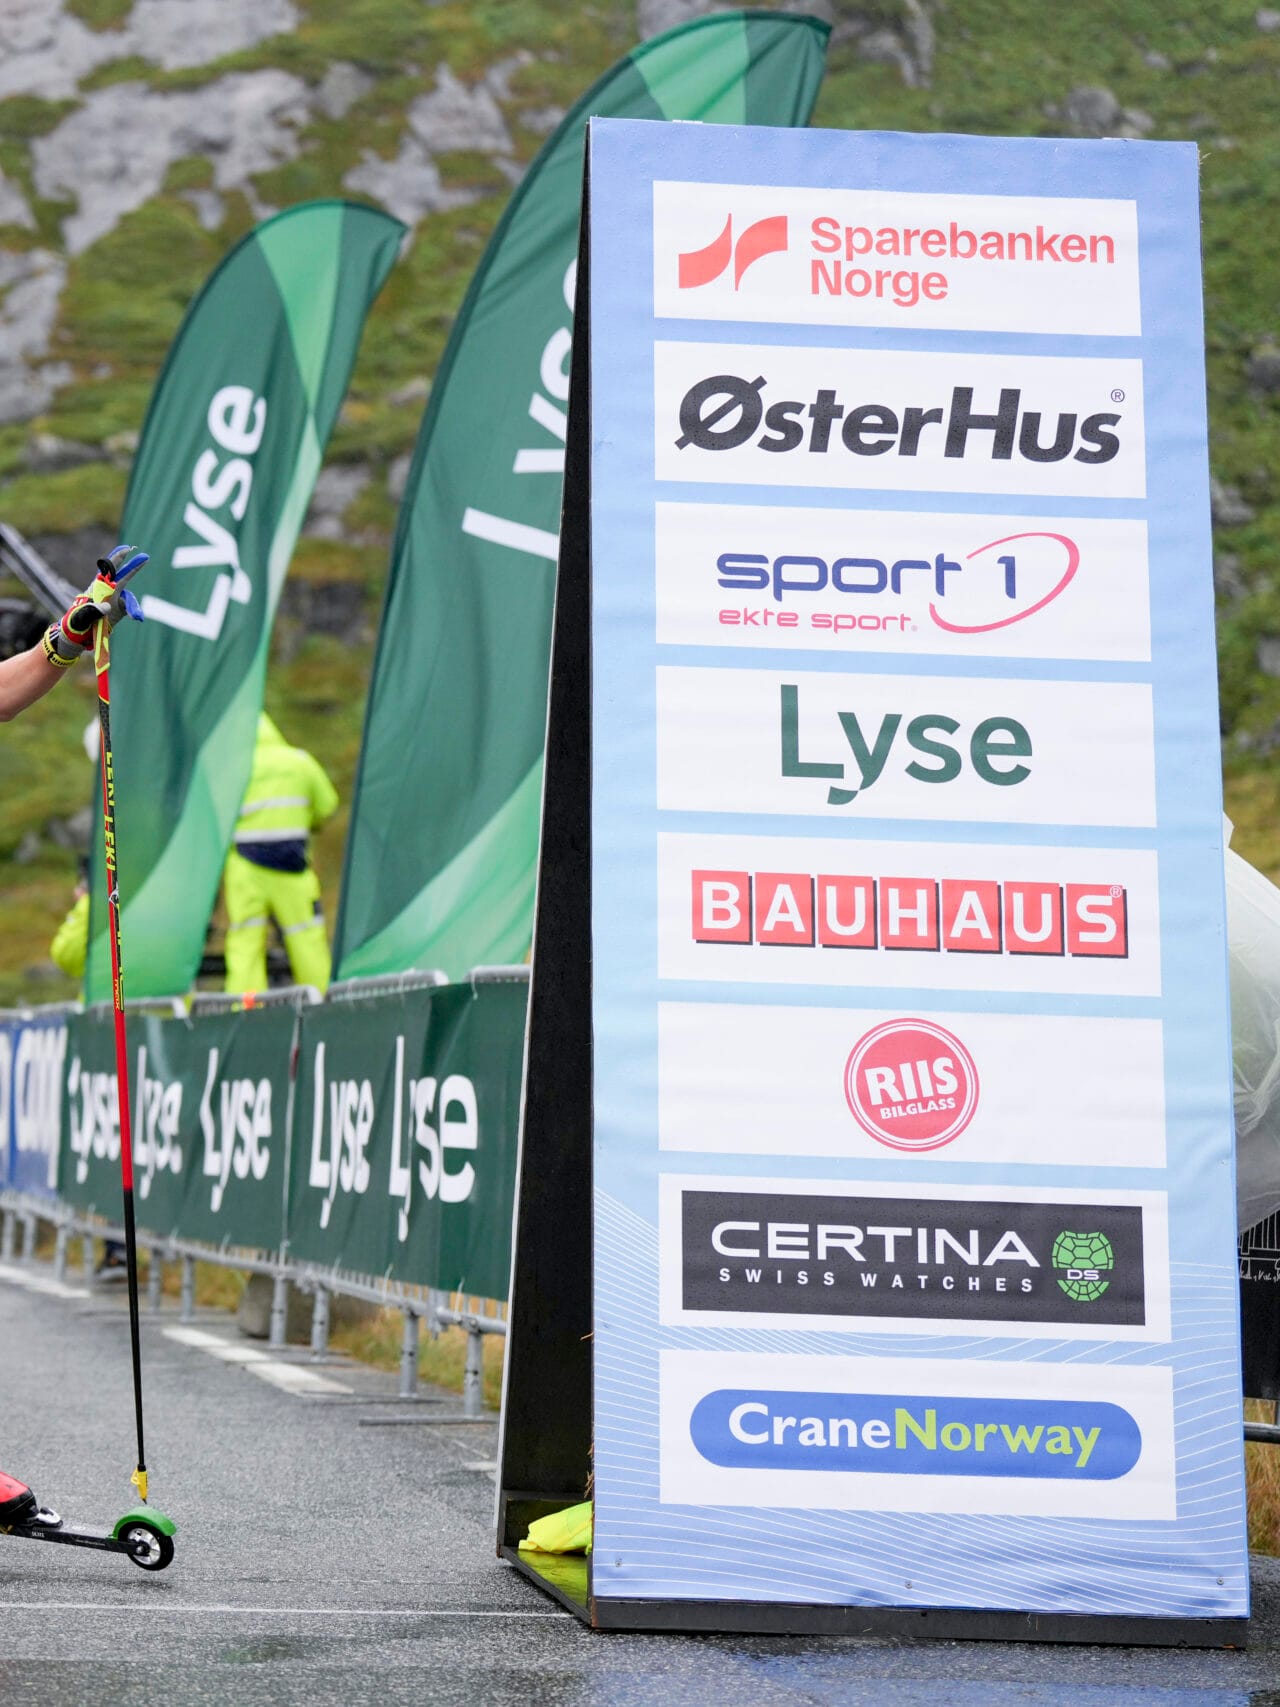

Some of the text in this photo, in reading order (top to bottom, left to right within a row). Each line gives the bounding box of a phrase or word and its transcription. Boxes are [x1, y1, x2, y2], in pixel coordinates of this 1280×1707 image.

[810, 216, 1115, 264] Sparebanken
[810, 260, 949, 307] Norge
[140, 385, 267, 641] Lyse
[716, 552, 1017, 603] sport 1
[718, 607, 800, 628] ekte
[780, 683, 1034, 806] Lyse
[864, 1056, 959, 1106] RIIS
[880, 1097, 957, 1120] BILGLASS
[200, 1047, 273, 1213] Lyse
[309, 1041, 375, 1230] Lyse
[389, 1035, 479, 1243] Lyse
[711, 1221, 1041, 1268] CERTINA
[719, 1268, 1033, 1293] SWISS WATCHES
[1066, 1269, 1100, 1280] DS
[728, 1402, 1101, 1468] CraneNorway
